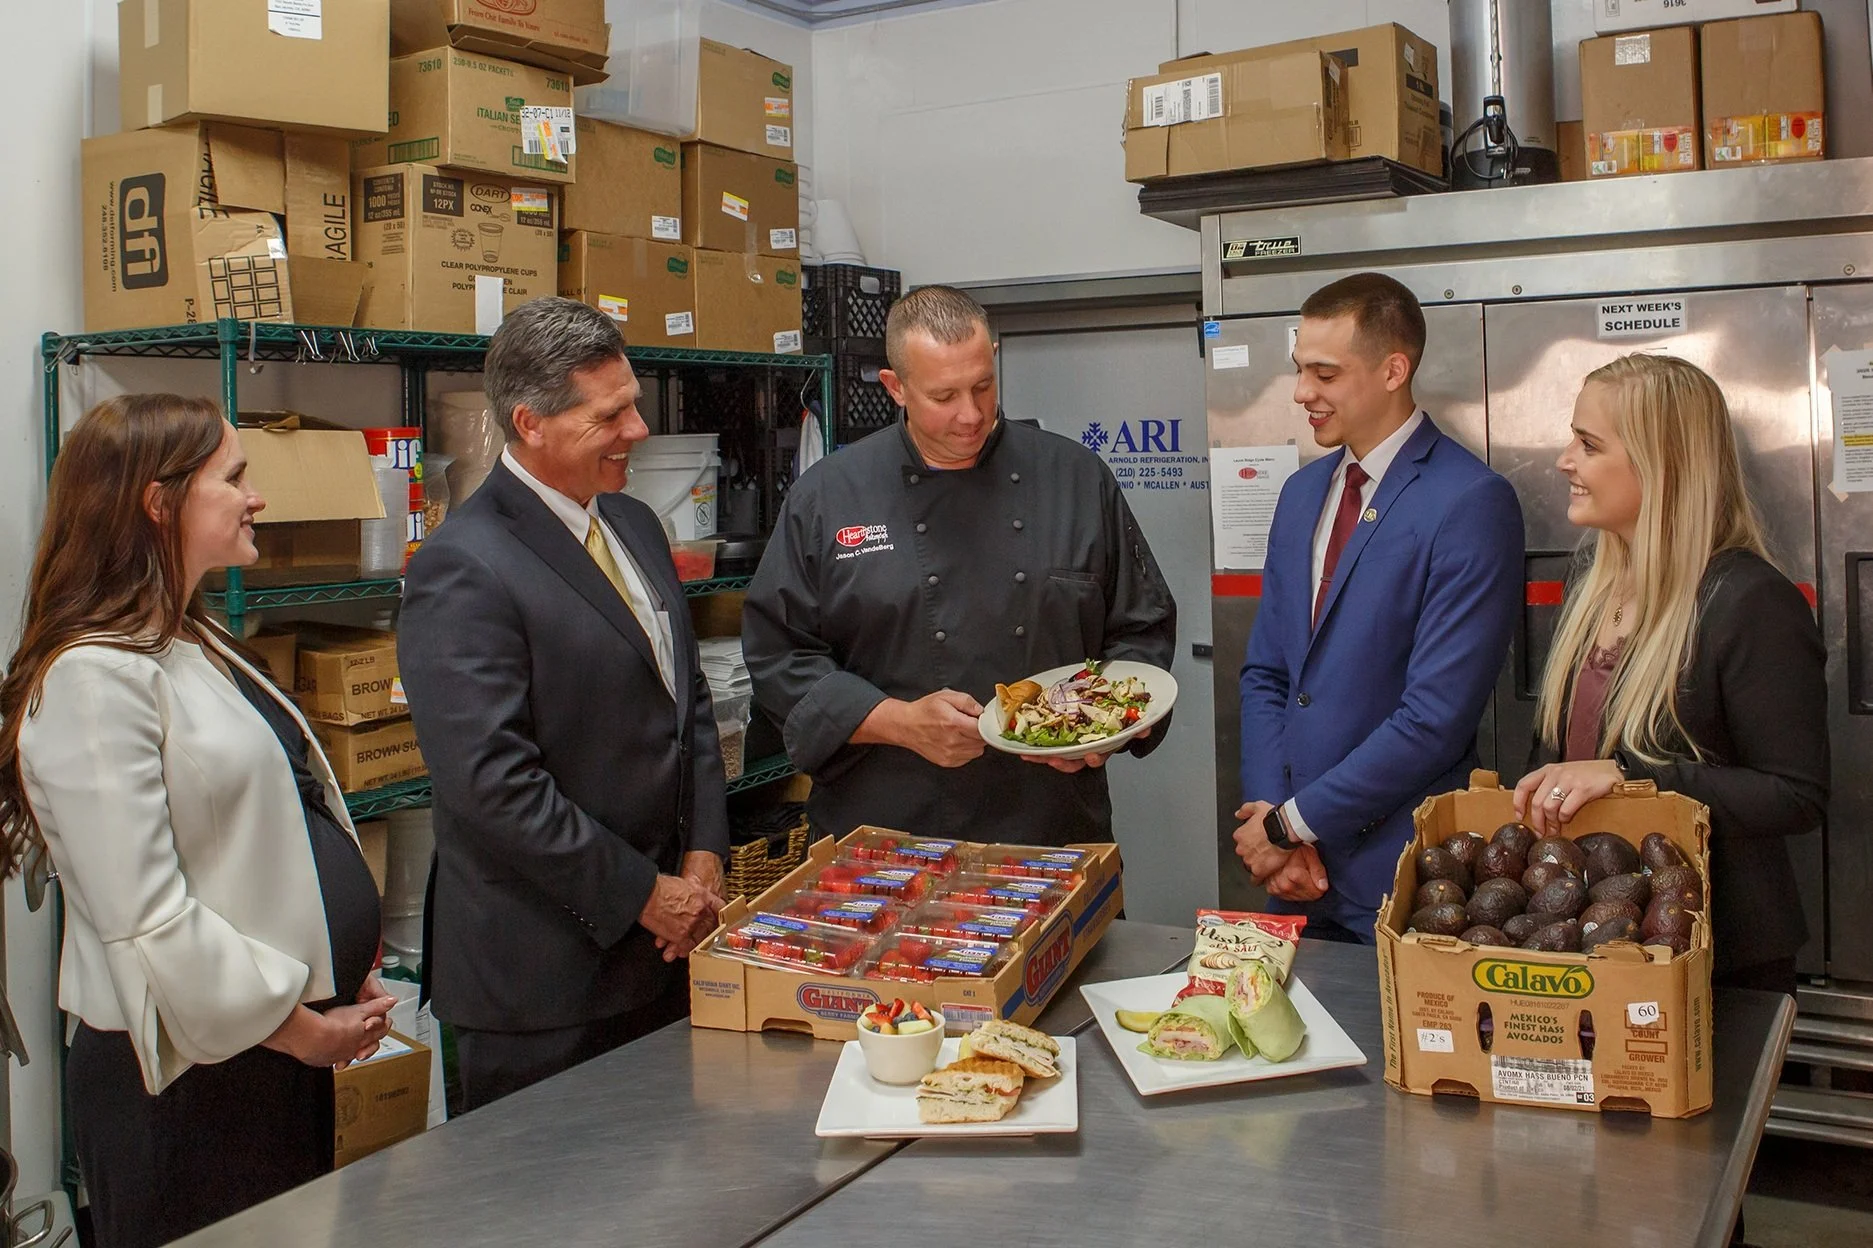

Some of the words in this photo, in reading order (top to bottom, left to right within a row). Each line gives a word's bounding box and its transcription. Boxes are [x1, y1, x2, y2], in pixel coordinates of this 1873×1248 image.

[476, 107, 508, 123] ITALIAN
[475, 187, 506, 199] DART
[368, 195, 386, 208] 1000
[433, 198, 454, 211] 12PX
[441, 260, 464, 271] CLEAR
[465, 262, 519, 275] POLYPROPYLENE
[520, 267, 537, 277] CUPS
[509, 288, 527, 296] CLAIR
[1602, 304, 1633, 314] NEXT
[1637, 301, 1682, 312] WEEK'S
[1605, 317, 1680, 331] SCHEDULE
[1110, 419, 1183, 453] ARI
[386, 440, 421, 469] Jif
[1140, 456, 1200, 464] REFRIGERATION,
[1116, 467, 1135, 479] (210)
[1139, 467, 1183, 477] 225-5493
[1144, 480, 1180, 490] MCALLEN
[835, 552, 855, 560] Jason
[322, 712, 344, 721] BAGS
[361, 711, 376, 719] NET
[357, 744, 400, 763] BROWN
[1233, 943, 1258, 953] SALT
[1486, 964, 1583, 993] Calavo
[803, 987, 874, 1013] GIANT
[1417, 991, 1445, 1000] PRODUCE
[1424, 999, 1449, 1008] MEXICO
[1638, 1005, 1657, 1017] 60
[1386, 1006, 1395, 1031] Name
[1422, 1019, 1438, 1028] EMP
[1510, 1013, 1558, 1025] MEXICO'S
[1504, 1021, 1537, 1031] FINEST
[1539, 1023, 1565, 1034] HASS
[1506, 1032, 1564, 1044] AVOCADOS
[1632, 1030, 1660, 1039] COUNT
[1388, 1032, 1397, 1053] First
[1389, 1054, 1397, 1069] The
[1629, 1053, 1666, 1063] GROWER
[1498, 1070, 1523, 1078] AVOMX
[1525, 1072, 1545, 1080] HASS
[1547, 1073, 1572, 1081] BUENO
[1584, 1093, 1595, 1102] 03
